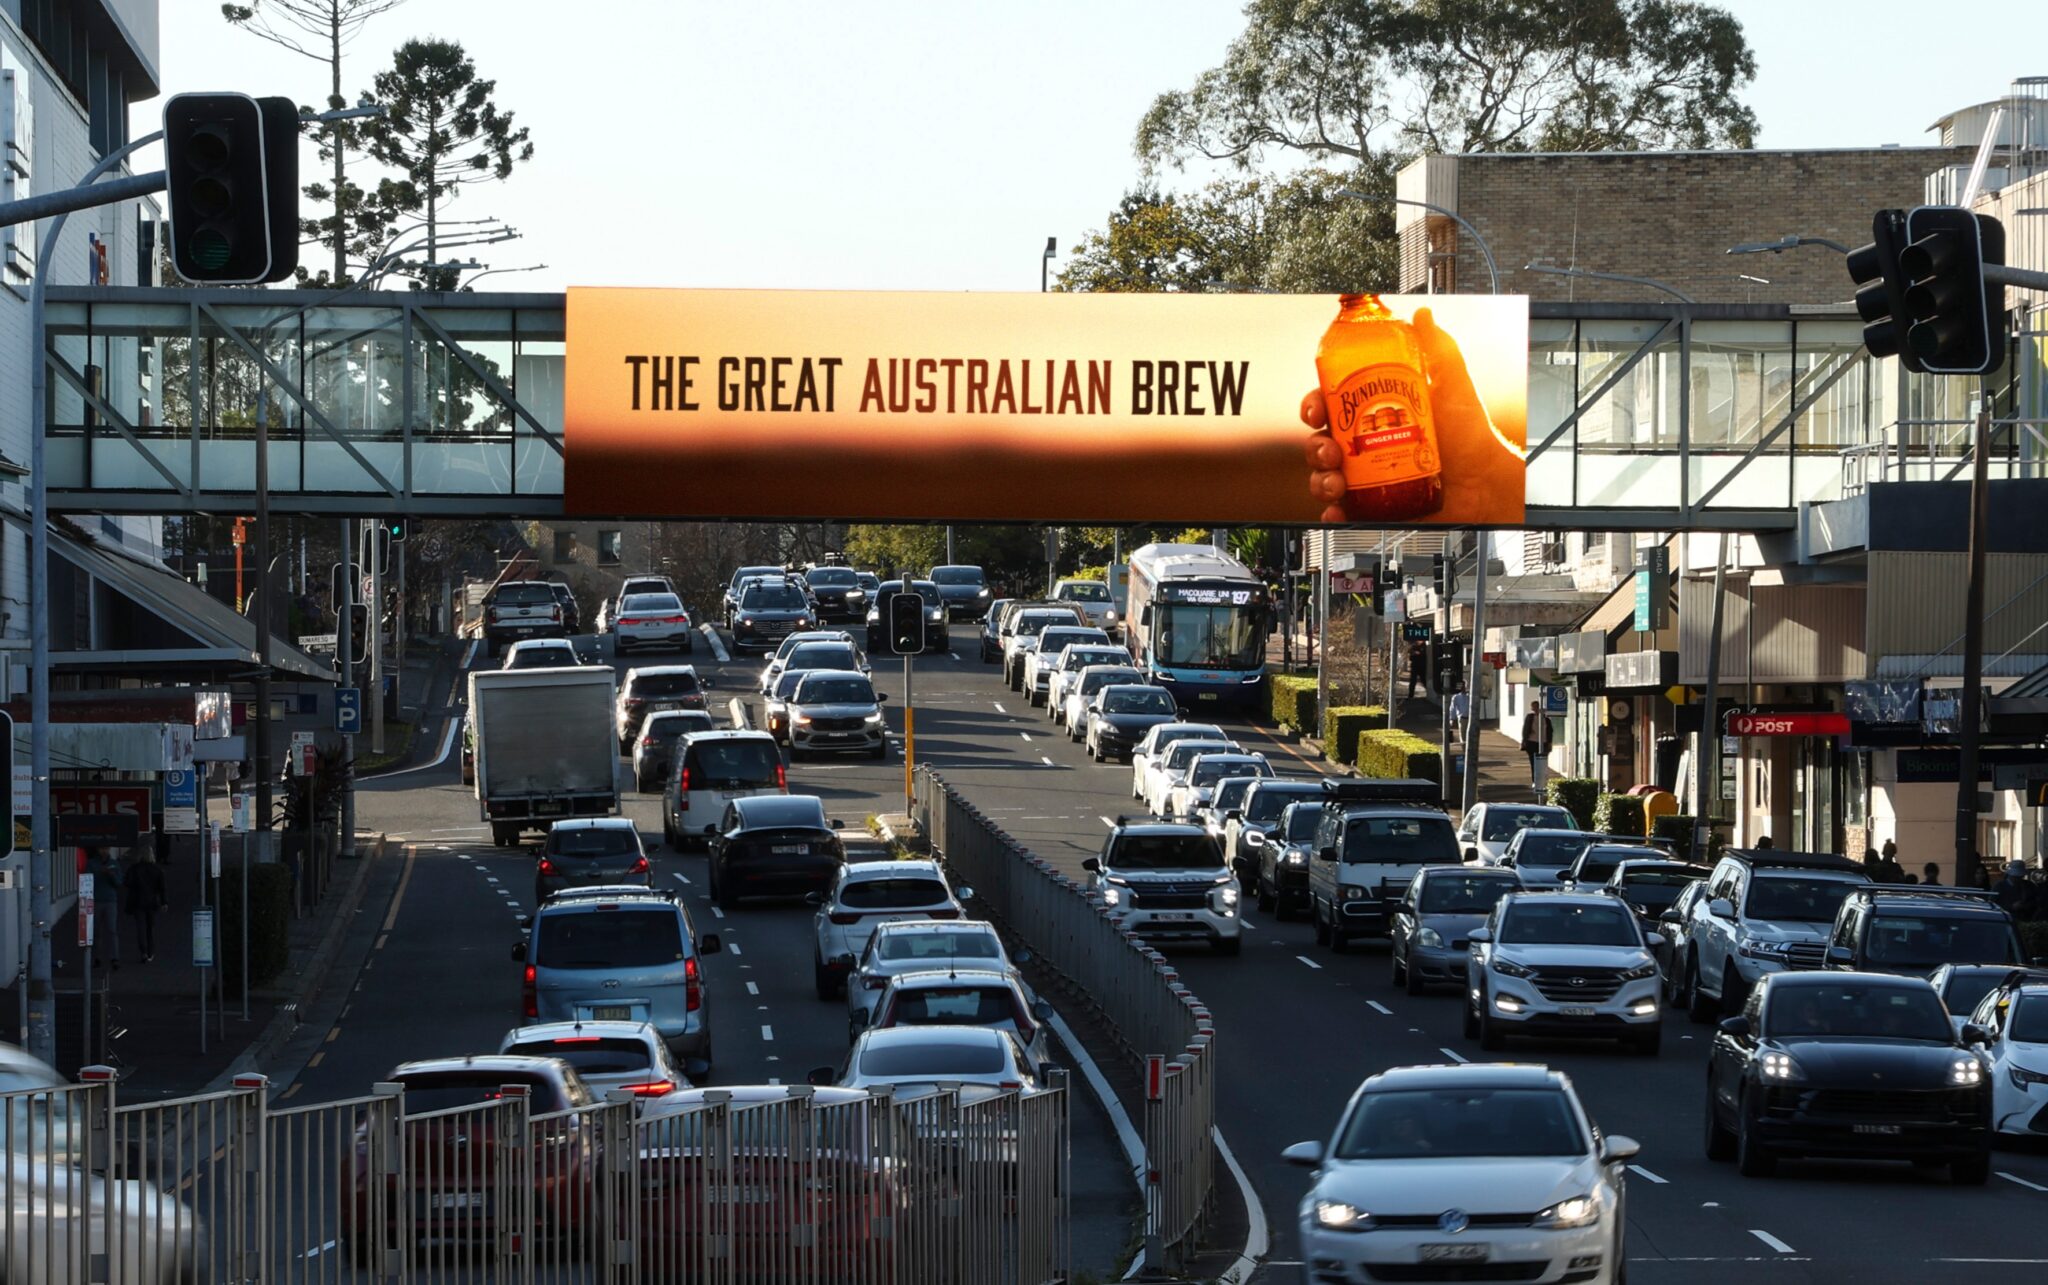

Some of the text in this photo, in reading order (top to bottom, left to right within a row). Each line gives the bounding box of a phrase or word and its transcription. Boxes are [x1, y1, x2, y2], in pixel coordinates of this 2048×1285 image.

[624, 355, 1249, 415] THE GREAT AUSTRALIAN BREW
[1337, 376, 1426, 432] BUNDABERG
[1365, 431, 1412, 446] GINGER BEER
[1232, 591, 1250, 605] 197
[1408, 629, 1428, 637] THE
[338, 707, 356, 728] P
[1755, 721, 1794, 733] POST
